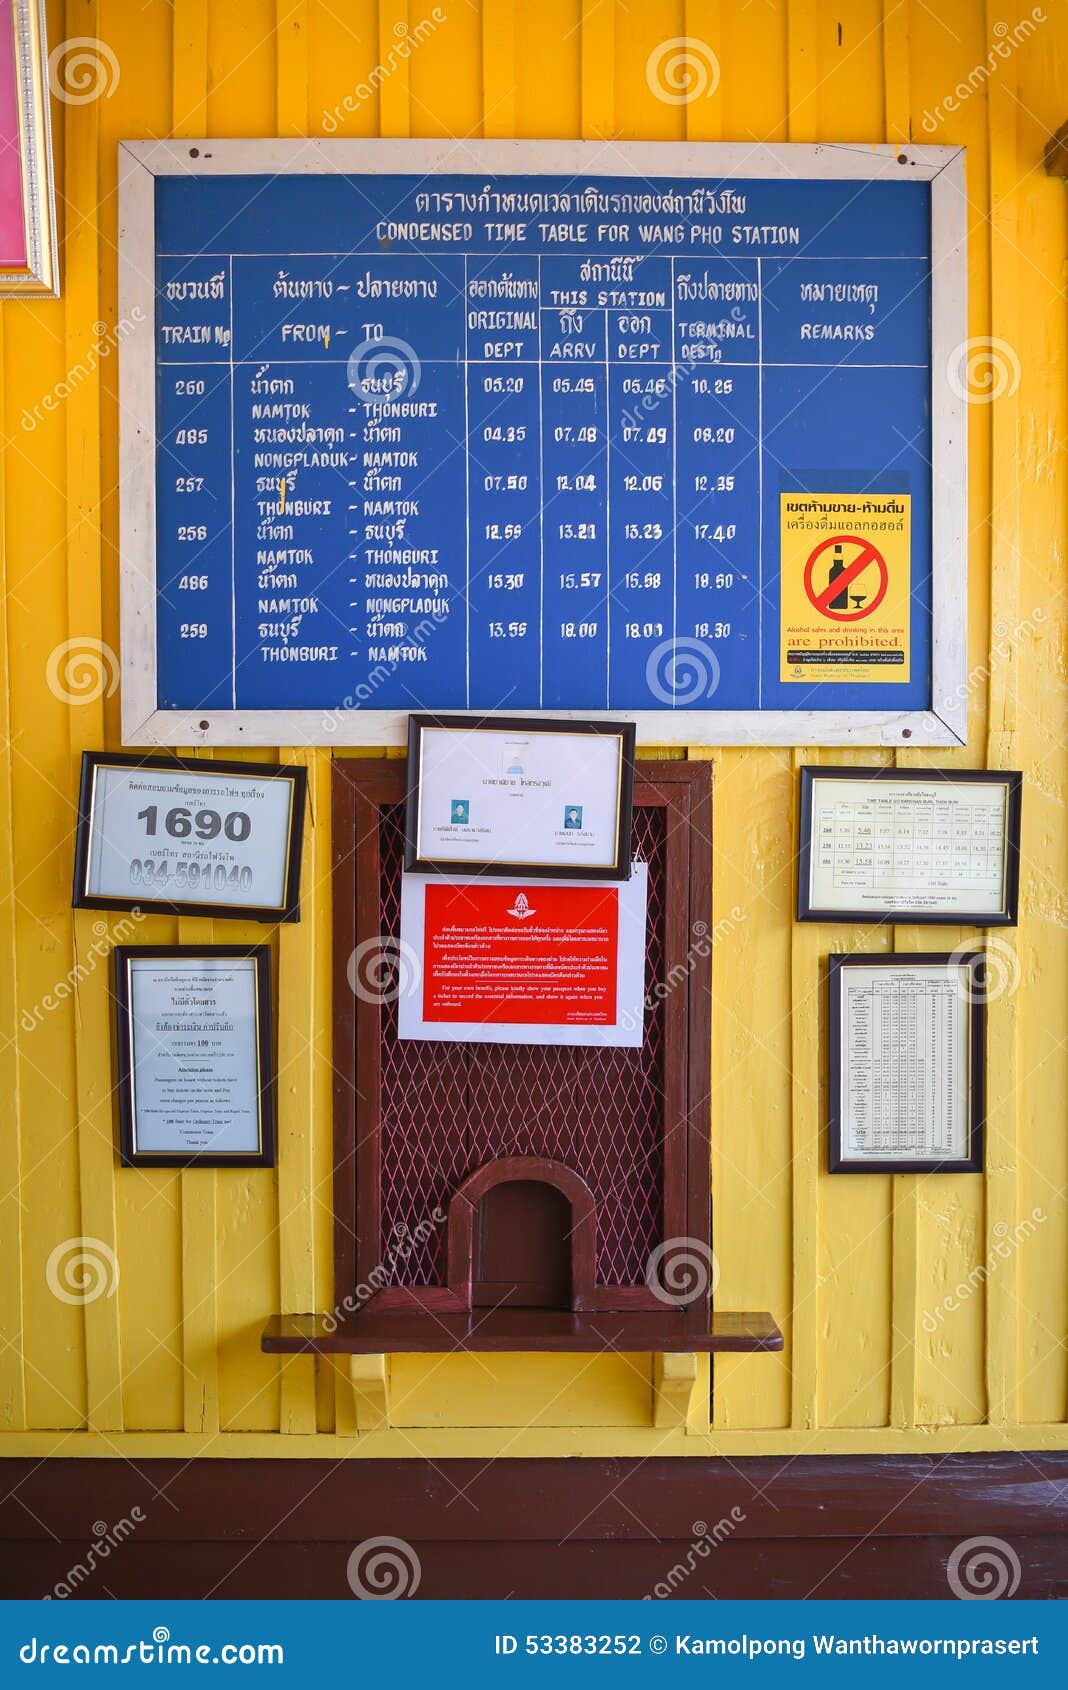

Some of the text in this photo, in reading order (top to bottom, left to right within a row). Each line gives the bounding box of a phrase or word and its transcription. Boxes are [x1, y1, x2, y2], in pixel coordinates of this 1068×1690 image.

[376, 222, 800, 244] CONDENSED TIME TABLE FOR WANG PHO STATION
[166, 271, 225, 300] ขบวนที่
[469, 273, 538, 299] ออกต้นทาง
[676, 270, 759, 301] ถึงปลายทาง
[550, 290, 666, 307] THIS STATION
[800, 283, 879, 315] หมายเหตุ
[468, 311, 538, 330] ORIGINAL
[559, 310, 583, 335] ถึง
[617, 316, 651, 335] ออก
[161, 325, 211, 345] TRAIN
[281, 322, 384, 343] FROM TO
[679, 322, 755, 339] TERMINAL
[800, 323, 875, 340] REMARKS
[484, 342, 524, 358] DEPT
[549, 343, 596, 359] ARRV
[618, 344, 661, 360] DEPT
[175, 380, 205, 395] 260
[250, 363, 406, 401] น้ำตก ธนบุรี
[484, 377, 524, 393] 05.20
[553, 378, 595, 393] 05.45
[252, 402, 438, 420] NAMTOK THONBURI
[175, 429, 208, 445] 485
[254, 418, 401, 450] หนองปลาดุก น้ำตก
[484, 426, 527, 442] 04.35
[554, 427, 597, 443] 07.48
[623, 427, 667, 443] 07.49
[693, 427, 735, 444] 08.20
[363, 451, 419, 468] NAMTOK
[175, 477, 205, 492] 257
[363, 467, 402, 492] น้ำตก
[484, 475, 528, 491] 07.50
[556, 474, 597, 492] 12.04
[623, 475, 663, 492] 12.06
[257, 500, 420, 517] THONBURI NAMTOK
[786, 499, 905, 514] เขตห้ามขาย-ห้ามดื่ม
[786, 513, 904, 531] เครื่องดื่มแอลกอฮอล์
[177, 525, 207, 541] 258
[256, 517, 406, 548] น้ำตก ธนบุรี
[625, 523, 663, 540] 13.23
[694, 524, 737, 543] 17.40
[256, 549, 439, 565] NAMTOK THONBURI
[178, 575, 209, 591] 486
[257, 564, 449, 597] น้ำตก หนองปลาดุก
[488, 573, 524, 590] 15.30
[559, 572, 601, 589] 15.57
[258, 597, 450, 614] NAMTOK NONGPLADUK
[180, 623, 208, 639] 259
[257, 614, 302, 645] ธนบุรี
[560, 622, 598, 638] 18.00
[694, 622, 731, 639] 18.30
[842, 627, 867, 635] drinking
[787, 635, 902, 649] are prohibited.
[261, 645, 428, 662] THONBURI NAMTOK
[137, 805, 251, 842] 1690
[128, 858, 253, 893] 034-591040
